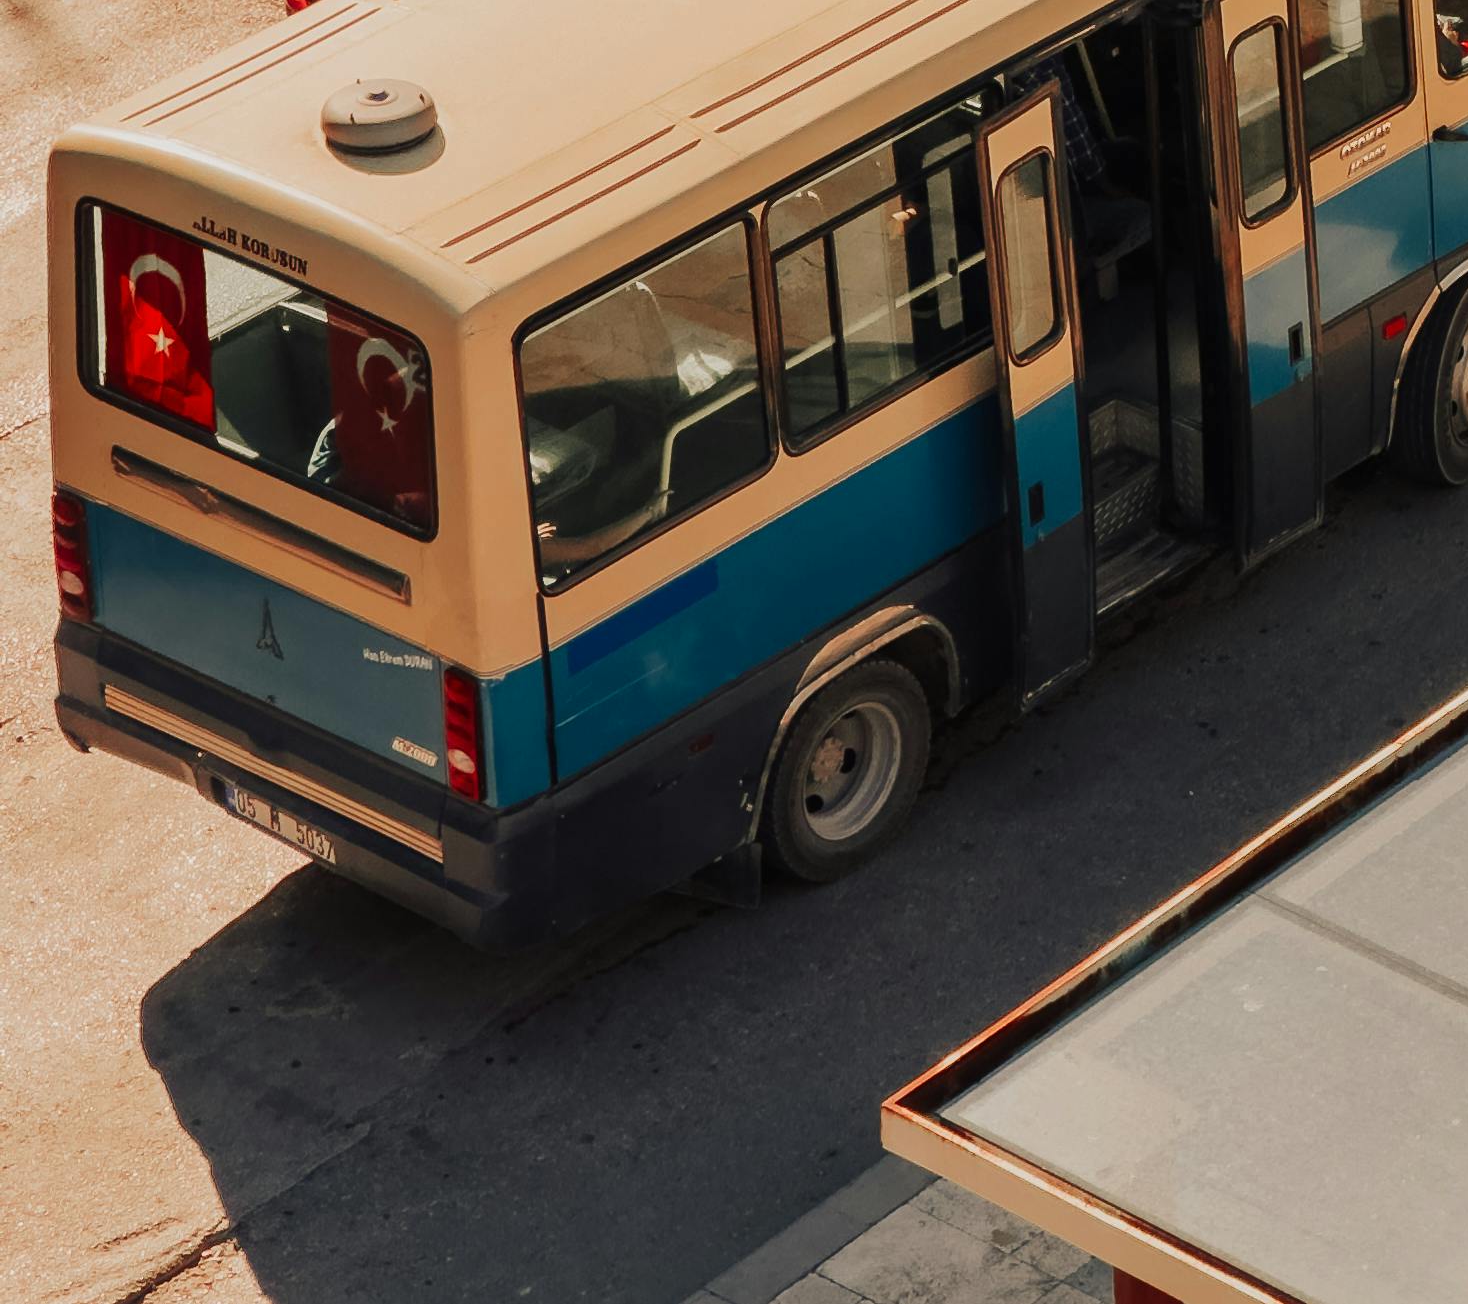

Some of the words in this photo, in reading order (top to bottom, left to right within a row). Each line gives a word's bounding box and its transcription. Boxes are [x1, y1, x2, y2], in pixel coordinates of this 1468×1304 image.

[238, 792, 256, 818] 05
[270, 807, 280, 831] M
[297, 823, 332, 859] 5037
